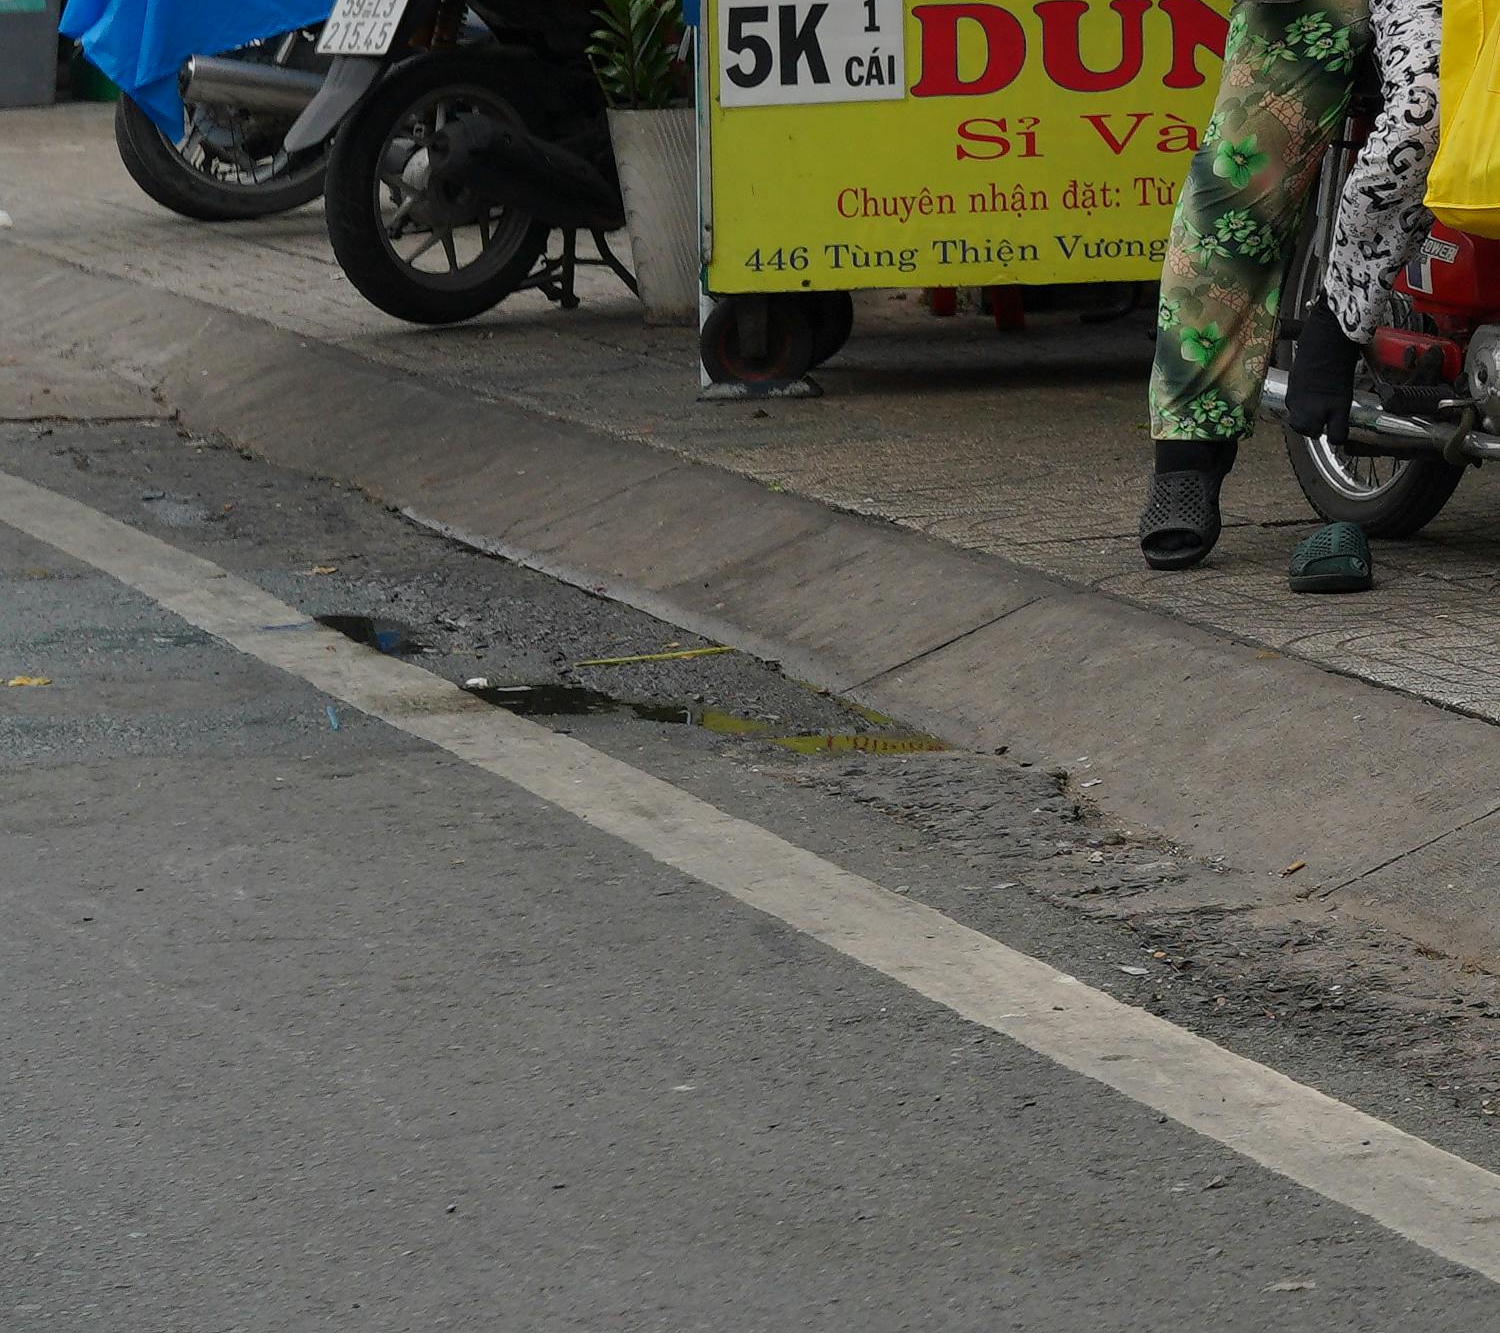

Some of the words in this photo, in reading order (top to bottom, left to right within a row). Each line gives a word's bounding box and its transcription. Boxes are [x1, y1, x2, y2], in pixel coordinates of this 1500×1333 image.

[322, 21, 393, 51] 215.45
[725, 4, 830, 89] 5K
[845, 47, 896, 87] CÁI
[955, 116, 1043, 161] Sỉ
[1081, 113, 1201, 155] Và
[837, 185, 956, 225] Chuyên
[968, 182, 1051, 217] nhận
[1062, 179, 1121, 215] đặt:
[1133, 175, 1175, 209] Từ
[745, 244, 810, 273] 446
[824, 242, 918, 273] Tùng
[932, 237, 1039, 270] Thiện
[1053, 233, 1166, 263] Vương
[1424, 237, 1457, 262] OWER
